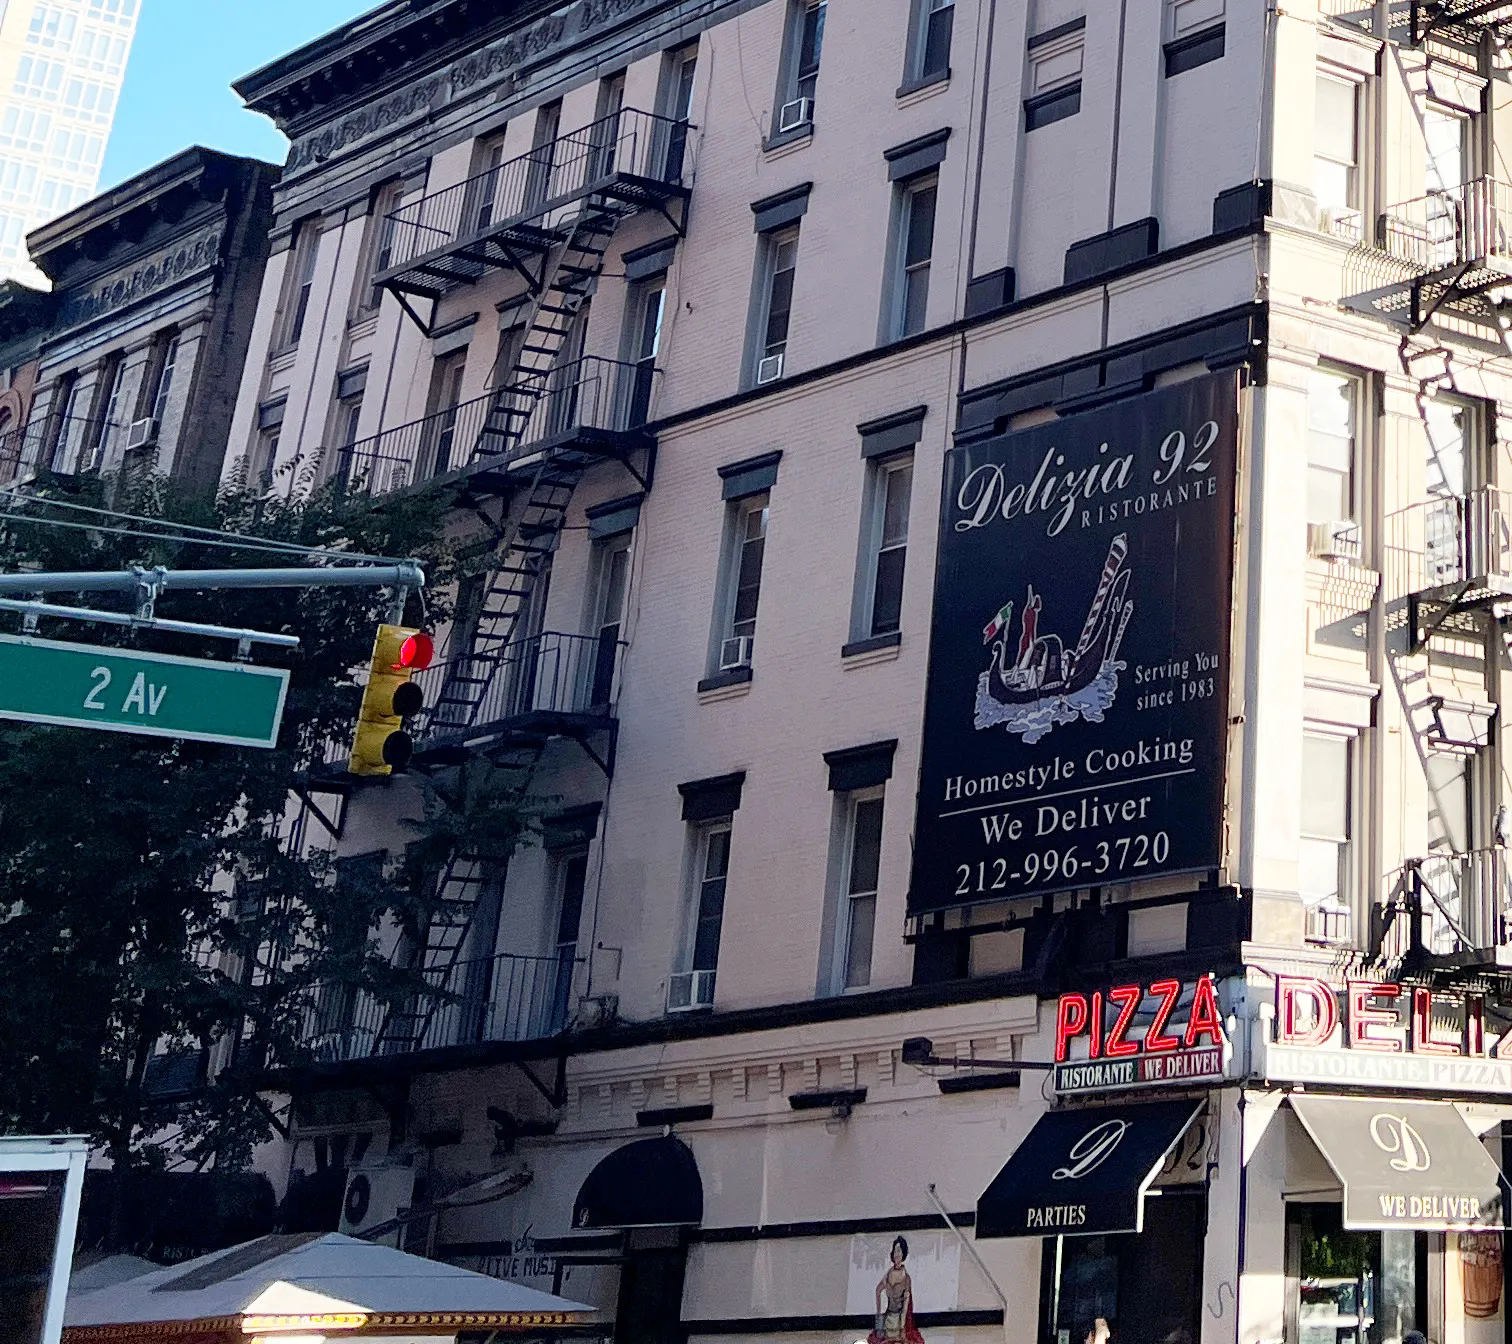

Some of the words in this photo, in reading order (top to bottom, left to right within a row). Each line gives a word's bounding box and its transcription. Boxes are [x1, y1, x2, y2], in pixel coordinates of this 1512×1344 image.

[955, 442, 1134, 537] Delizia
[1153, 421, 1219, 485] 92
[1081, 476, 1217, 528] RISTORANTE
[1135, 659, 1189, 684] Serving
[1195, 652, 1218, 672] You
[83, 666, 112, 710] 2
[121, 671, 168, 716] Av
[1136, 690, 1174, 711] since
[1181, 677, 1214, 701] 1983
[943, 757, 1075, 801] Homestyle
[1085, 737, 1194, 774] Cooking
[980, 813, 1023, 845] We
[1035, 796, 1151, 837] Deliver
[955, 831, 1169, 897] 212-996-3720
[1055, 974, 1223, 1062] PIZZA
[1060, 1062, 1134, 1090] RISTORANTE
[1143, 1057, 1163, 1081] WE
[1166, 1051, 1220, 1078] DELIVER
[1274, 1052, 1428, 1082] RISTORANTE
[1432, 1062, 1509, 1086] PIZZA
[1026, 1204, 1086, 1228] PARTIES
[1379, 1194, 1406, 1218] WE
[1408, 1195, 1481, 1219] DELIVER
[523, 1255, 562, 1277] MUSI
